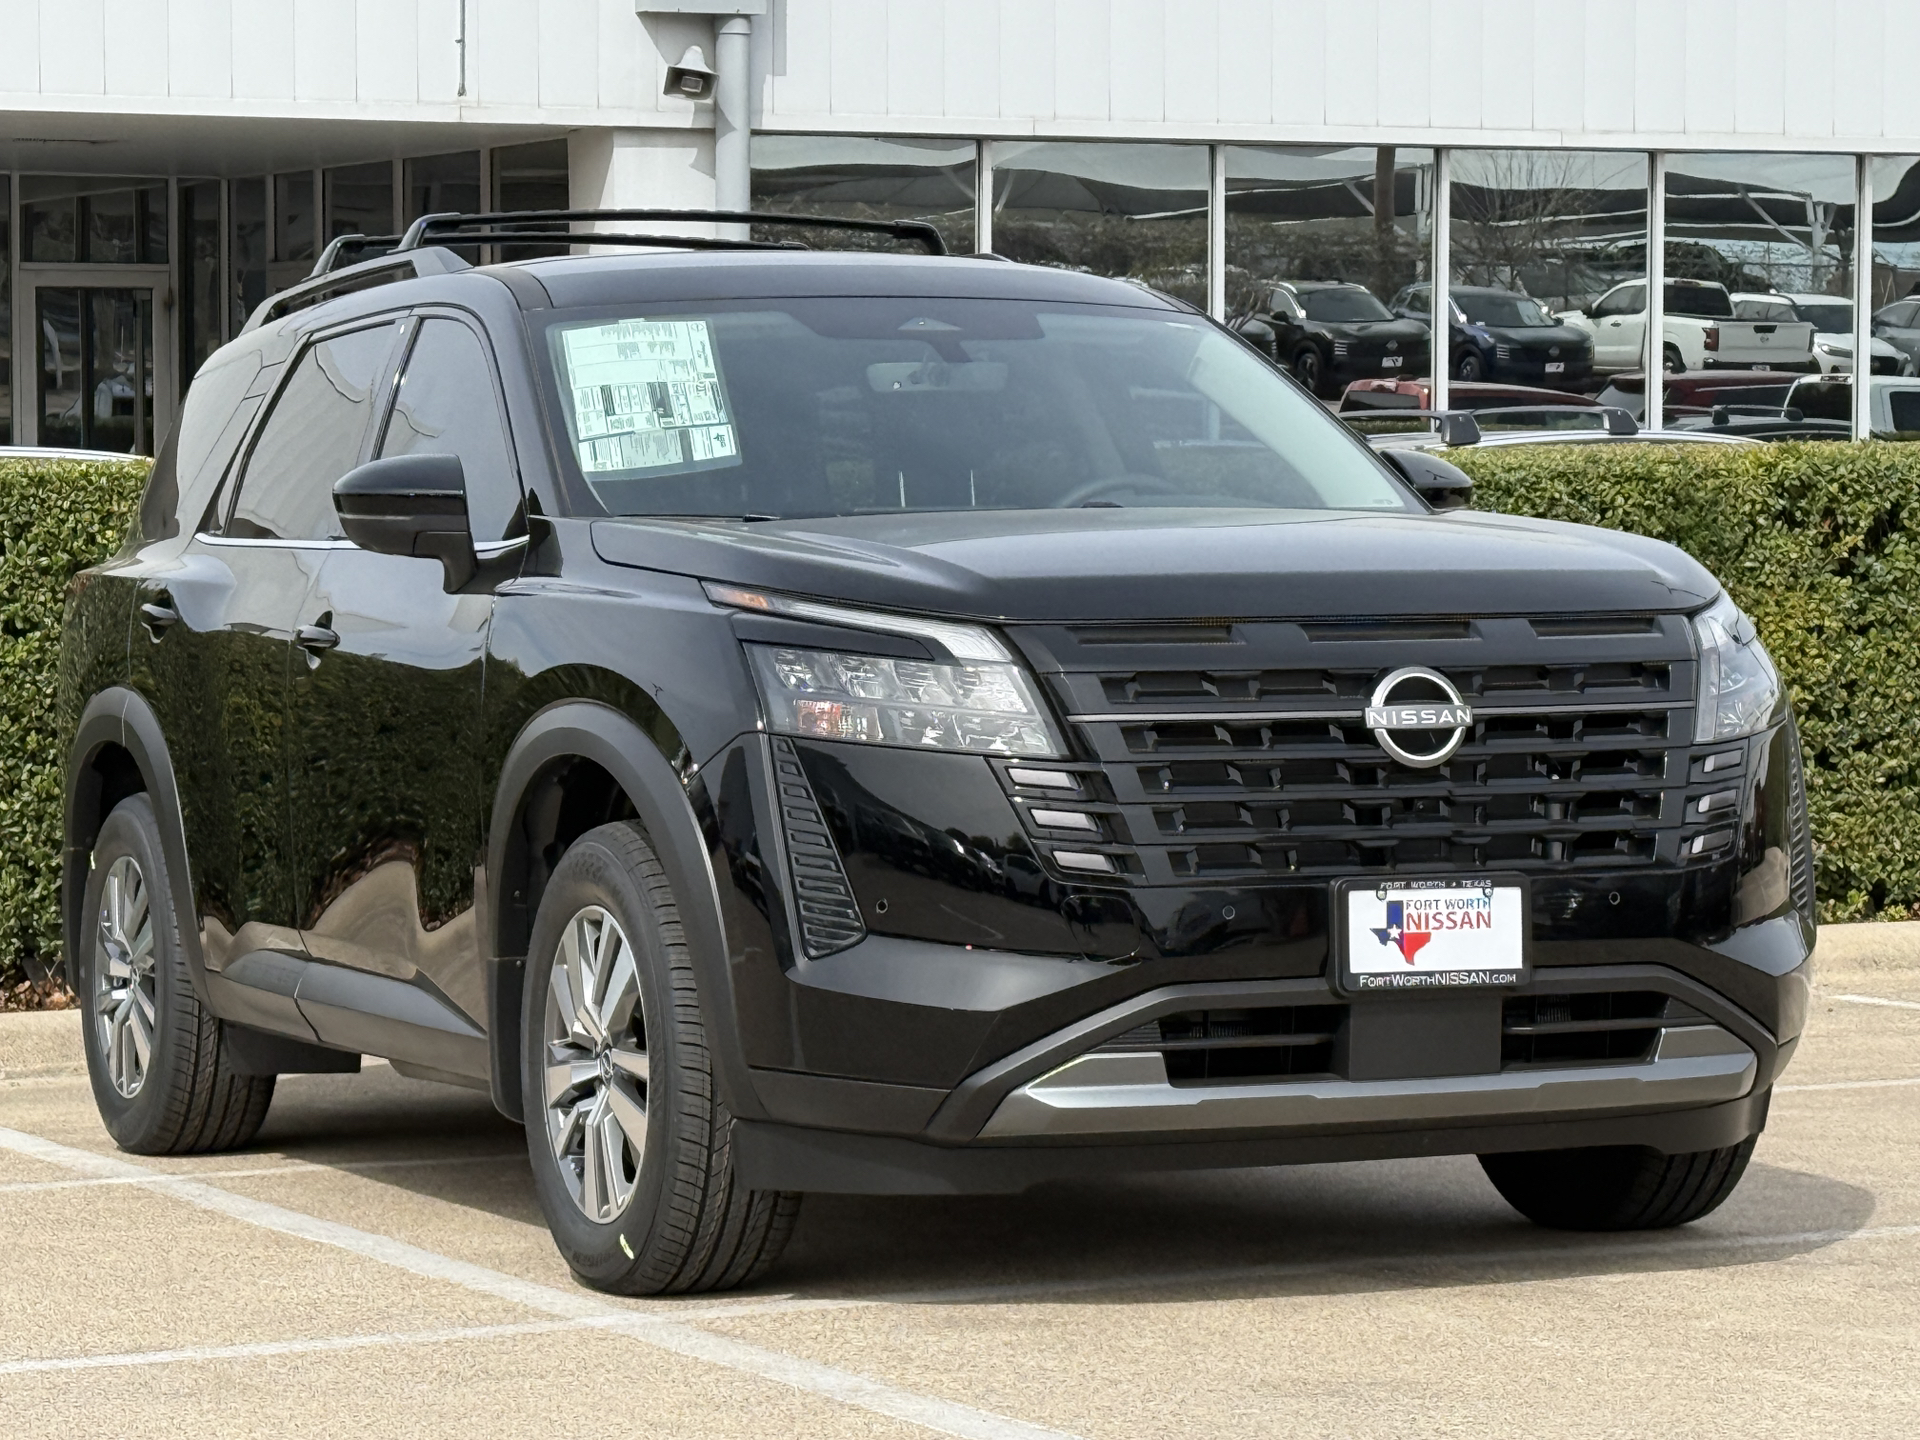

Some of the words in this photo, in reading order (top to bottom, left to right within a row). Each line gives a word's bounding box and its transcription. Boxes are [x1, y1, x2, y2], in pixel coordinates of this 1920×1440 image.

[1369, 709, 1471, 725] NISSAN
[1380, 882, 1407, 890] FORT
[1410, 881, 1446, 889] WORTH
[1461, 880, 1492, 888] TEXAS
[1405, 899, 1441, 911] FORT
[1444, 898, 1491, 910] WORTH
[1406, 911, 1492, 931] NISSAN
